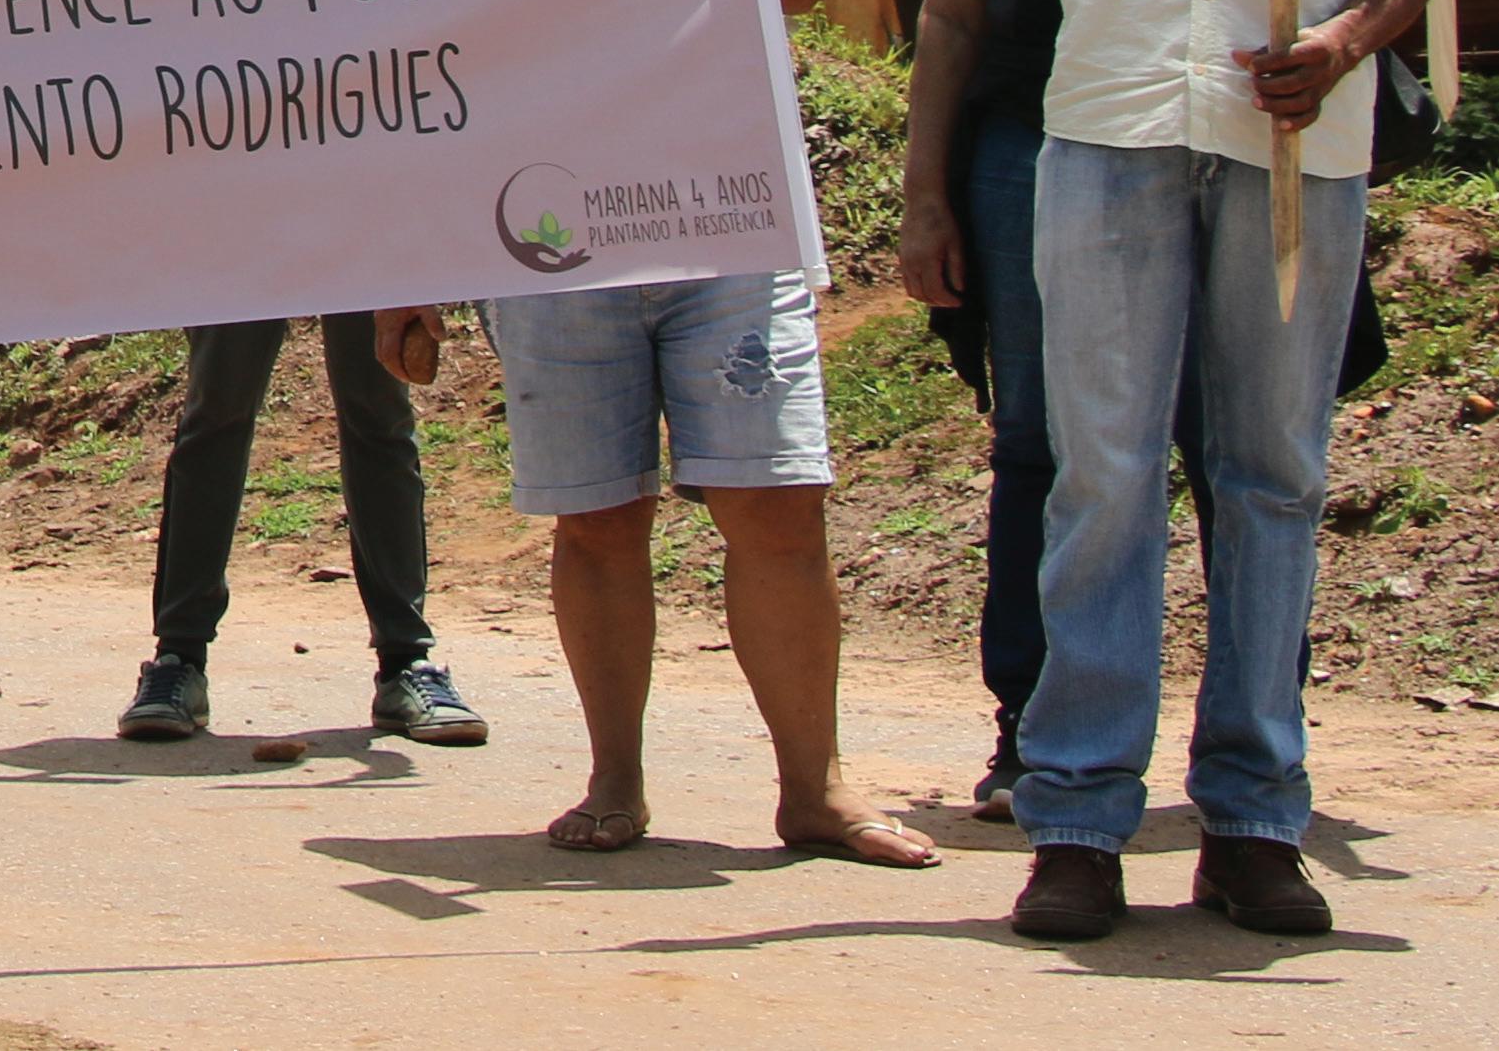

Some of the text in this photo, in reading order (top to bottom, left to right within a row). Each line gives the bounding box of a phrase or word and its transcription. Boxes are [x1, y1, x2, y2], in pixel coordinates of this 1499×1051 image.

[155, 42, 467, 155] RODRIGUES
[584, 171, 772, 218] MARIANA 4 ANOS
[588, 209, 775, 248] PLANTANDO A RESISTÊNCIA
